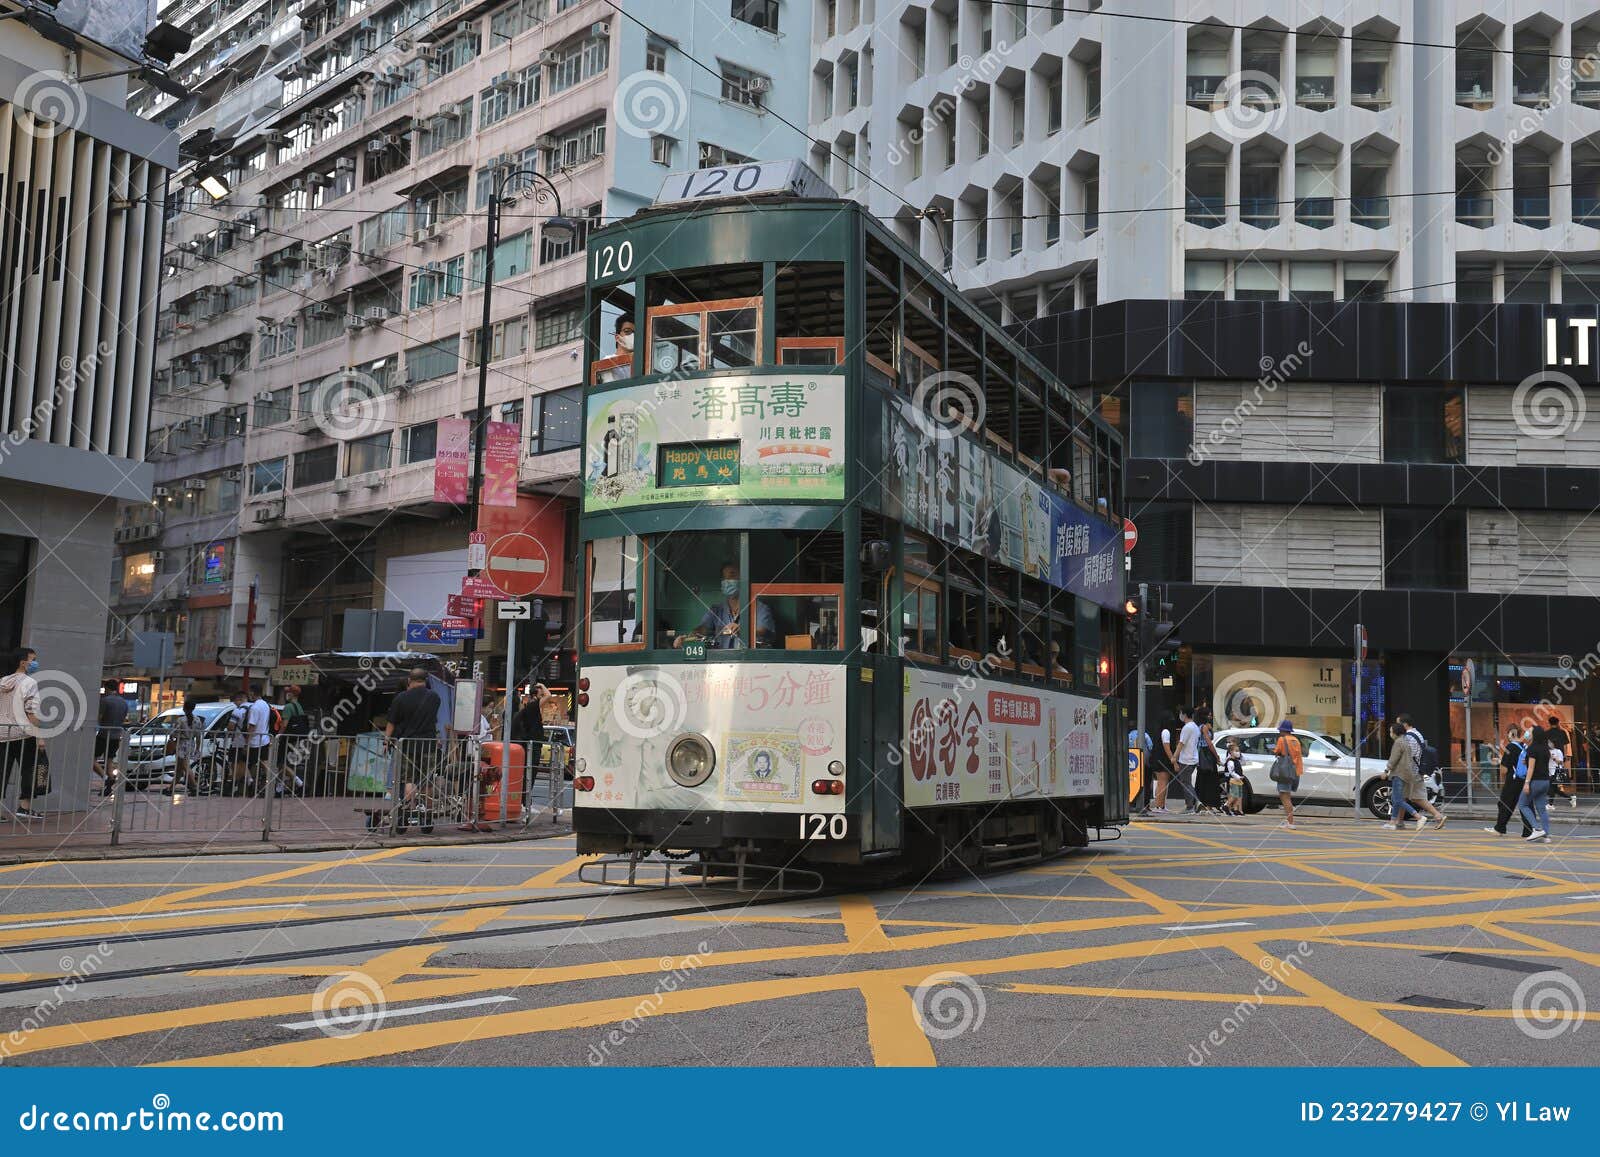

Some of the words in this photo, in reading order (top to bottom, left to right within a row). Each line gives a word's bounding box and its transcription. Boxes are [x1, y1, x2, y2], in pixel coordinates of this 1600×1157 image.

[681, 165, 762, 198] 120
[594, 241, 633, 280] 120
[1547, 319, 1596, 365] I.T
[760, 427, 832, 440] 川貝枇杷露
[666, 449, 700, 465] Happy
[706, 447, 740, 463] Valley
[673, 464, 732, 481] 跑馬地
[686, 646, 704, 656] 049
[1320, 668, 1334, 681] I.T
[800, 813, 848, 841] 120
